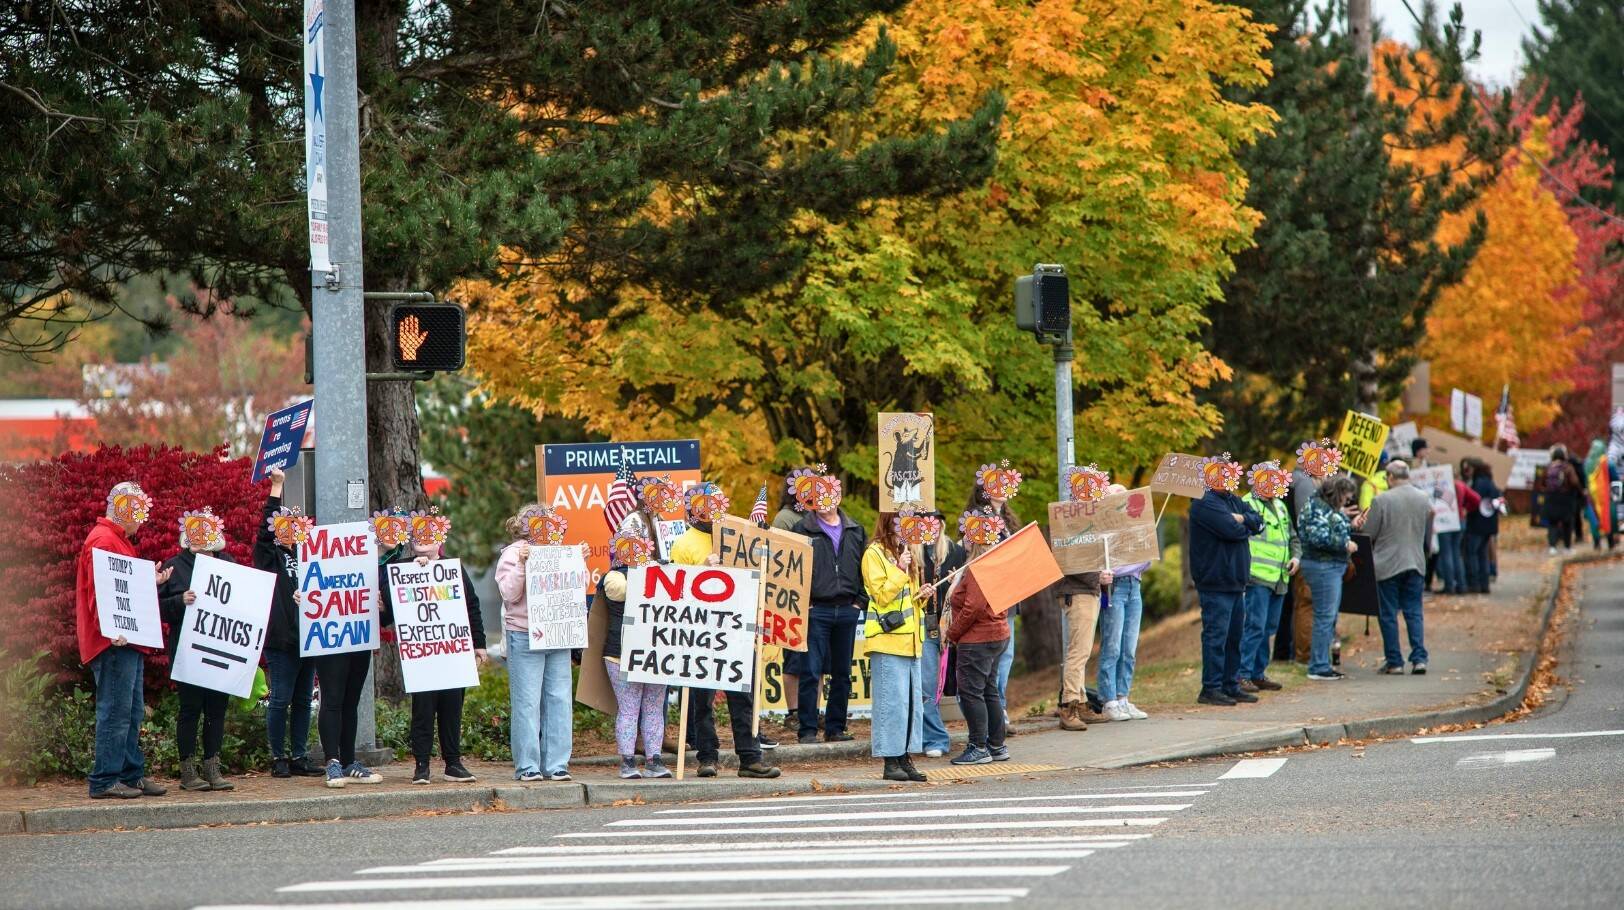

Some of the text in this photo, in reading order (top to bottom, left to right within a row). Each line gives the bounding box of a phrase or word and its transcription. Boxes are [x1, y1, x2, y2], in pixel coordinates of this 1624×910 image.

[1347, 413, 1383, 443] DEFEND
[566, 448, 681, 467] PRIME RETAIL
[302, 529, 369, 562] MAKE
[719, 526, 804, 587] FACISM
[107, 556, 133, 576] TRUMP'S
[301, 561, 365, 592] AMERICA
[529, 559, 560, 573] MORE
[114, 577, 129, 594] MOM
[204, 573, 232, 605] NO
[397, 584, 461, 604] EXISTANCE
[530, 569, 585, 596] AMERICAN
[643, 565, 736, 603] NO
[115, 596, 132, 612] TOOK
[304, 588, 371, 619] SANE
[545, 589, 574, 607] THAN
[765, 582, 801, 616] FOR
[112, 613, 139, 632] TYLENOL
[417, 602, 441, 623] OR
[639, 603, 743, 630] TYRANTS
[303, 619, 371, 651] AGAIN
[398, 623, 446, 642] EXPECT
[544, 619, 587, 648] KINGS
[651, 625, 728, 652] KINGS
[762, 609, 803, 647] ERS
[399, 639, 471, 661] RESISTANCE
[627, 649, 743, 683] FACISTS
